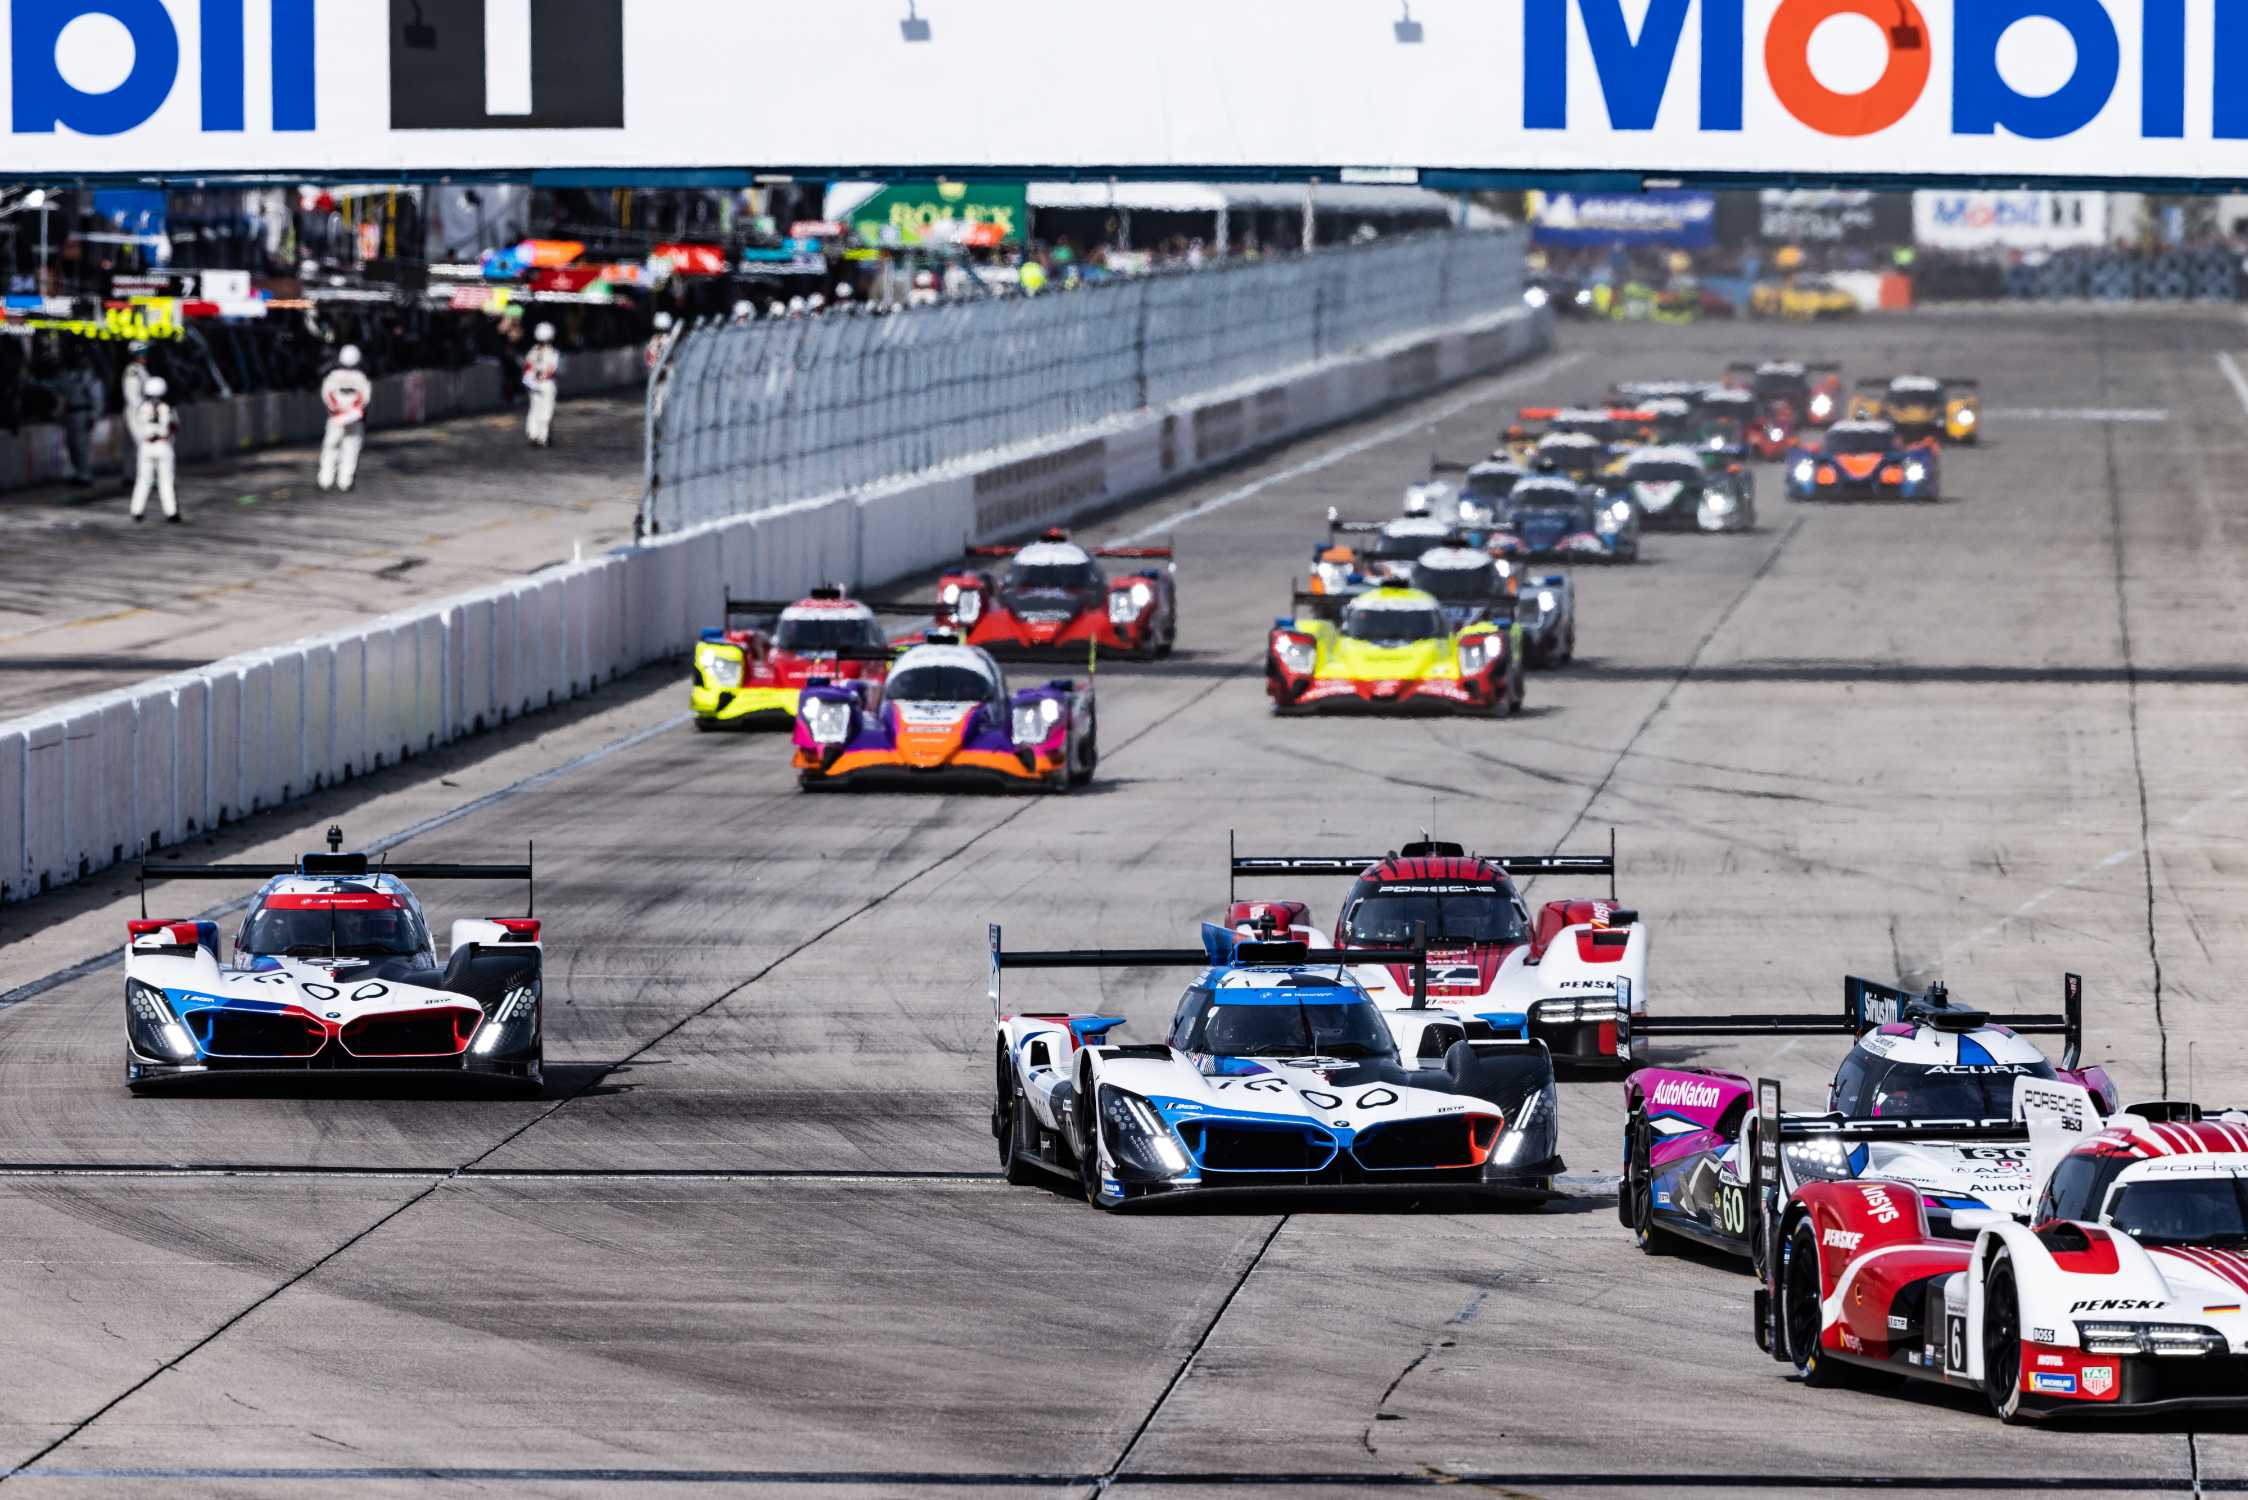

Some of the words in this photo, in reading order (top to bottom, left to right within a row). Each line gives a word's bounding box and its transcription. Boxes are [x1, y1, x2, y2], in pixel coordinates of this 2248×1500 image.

[1924, 1065, 2034, 1075] ACURA
[1652, 1079, 1720, 1108] AutoNation
[2025, 1089, 2083, 1116] PORSCHE
[2061, 1116, 2083, 1132] 963
[1972, 1148, 2031, 1160] 60
[1723, 1186, 1745, 1234] 60
[1857, 1185, 1899, 1224] Ansys
[1822, 1229, 1864, 1250] PENSKE
[2069, 1299, 2170, 1314] PENSKE
[1951, 1317, 1962, 1369] 6
[2034, 1328, 2054, 1342] BOSS
[2084, 1368, 2112, 1379] TAG
